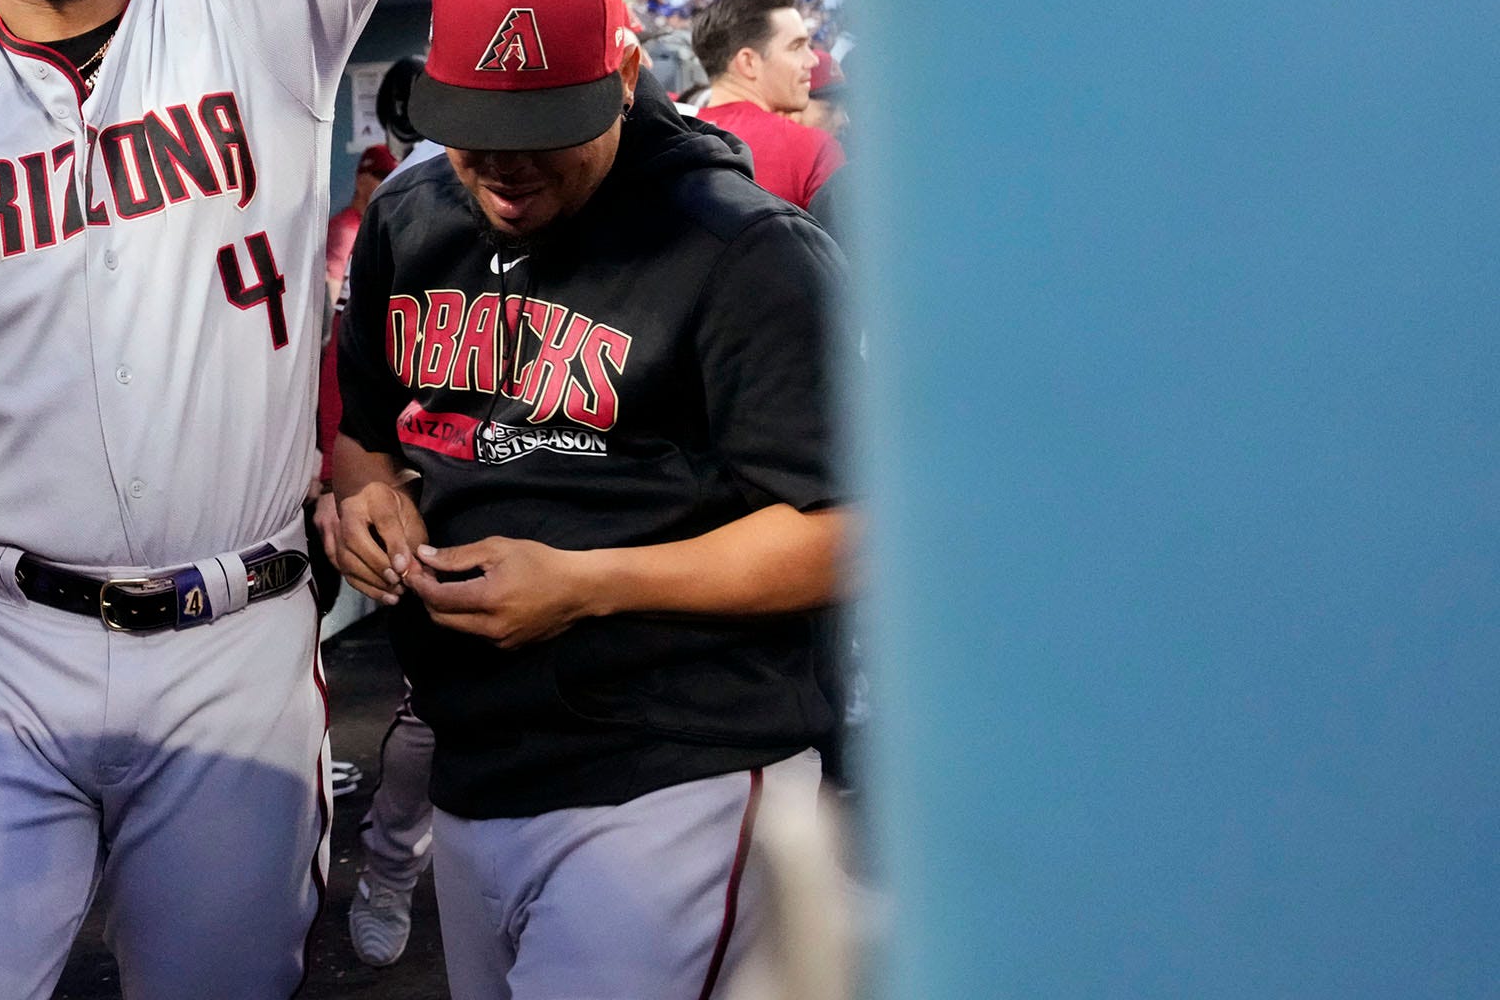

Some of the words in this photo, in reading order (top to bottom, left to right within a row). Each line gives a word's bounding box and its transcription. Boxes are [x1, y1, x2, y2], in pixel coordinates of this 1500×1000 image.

[216, 230, 290, 351] 4
[386, 289, 633, 432] D-BACKS
[183, 585, 204, 617] 4
